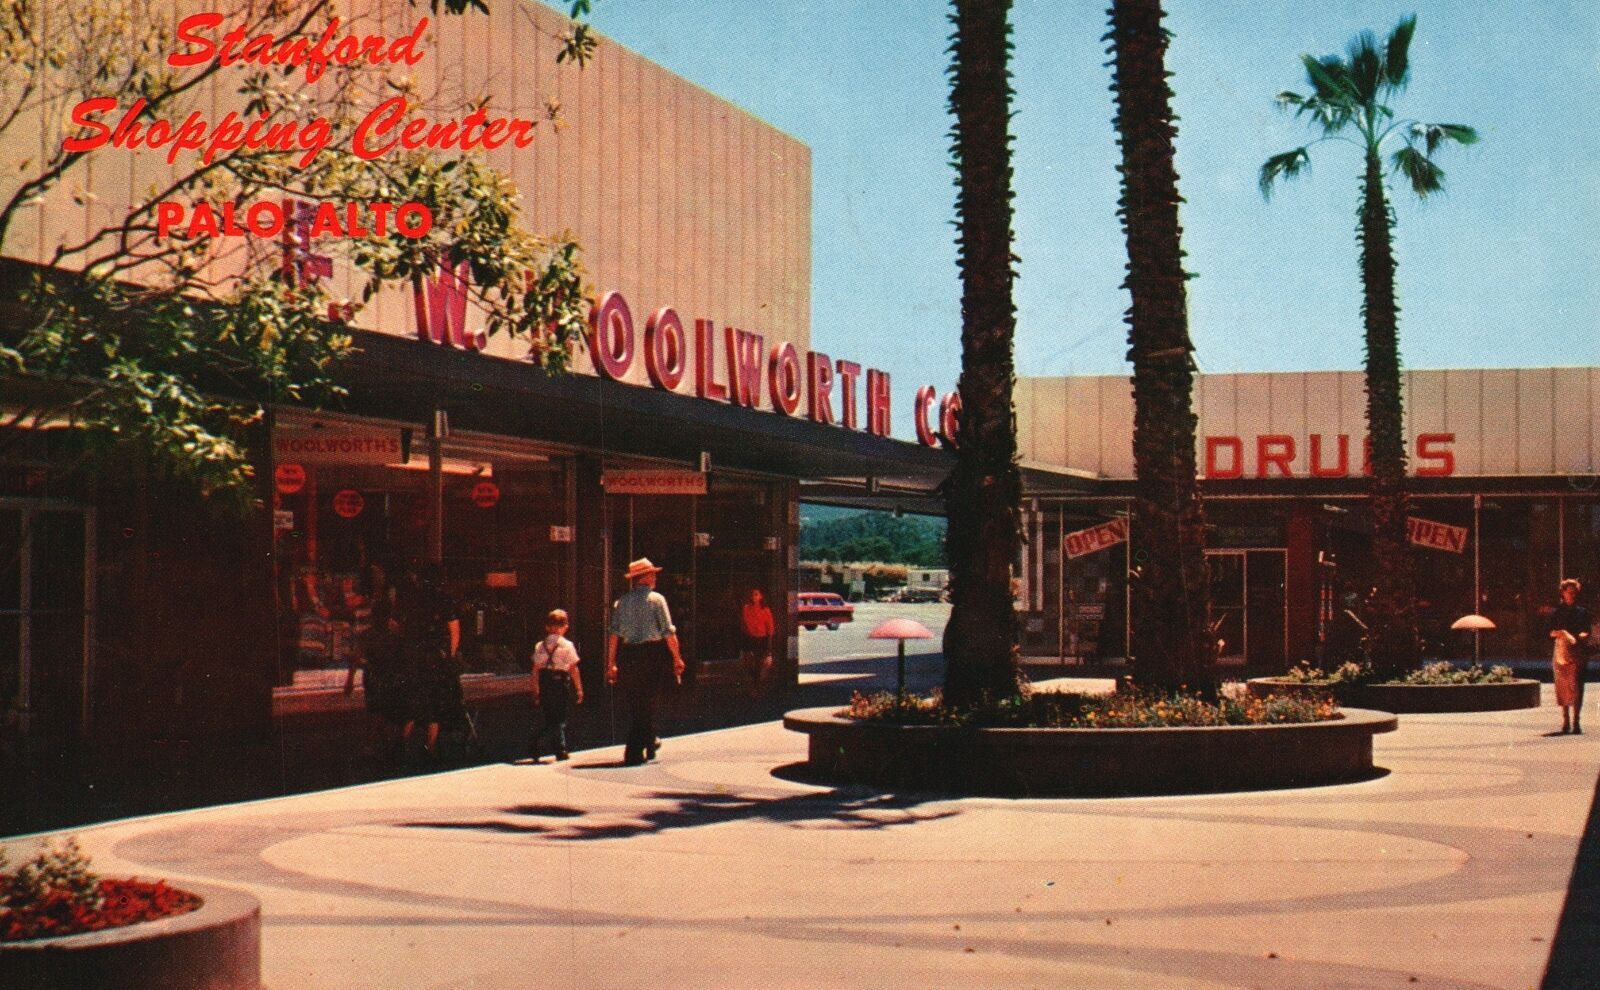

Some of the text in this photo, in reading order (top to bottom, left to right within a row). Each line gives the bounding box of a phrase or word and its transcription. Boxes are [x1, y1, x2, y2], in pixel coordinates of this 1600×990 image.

[525, 270, 892, 438] OOLWORTH
[1204, 434, 1455, 478] DRUS
[1067, 519, 1128, 555] OPEN
